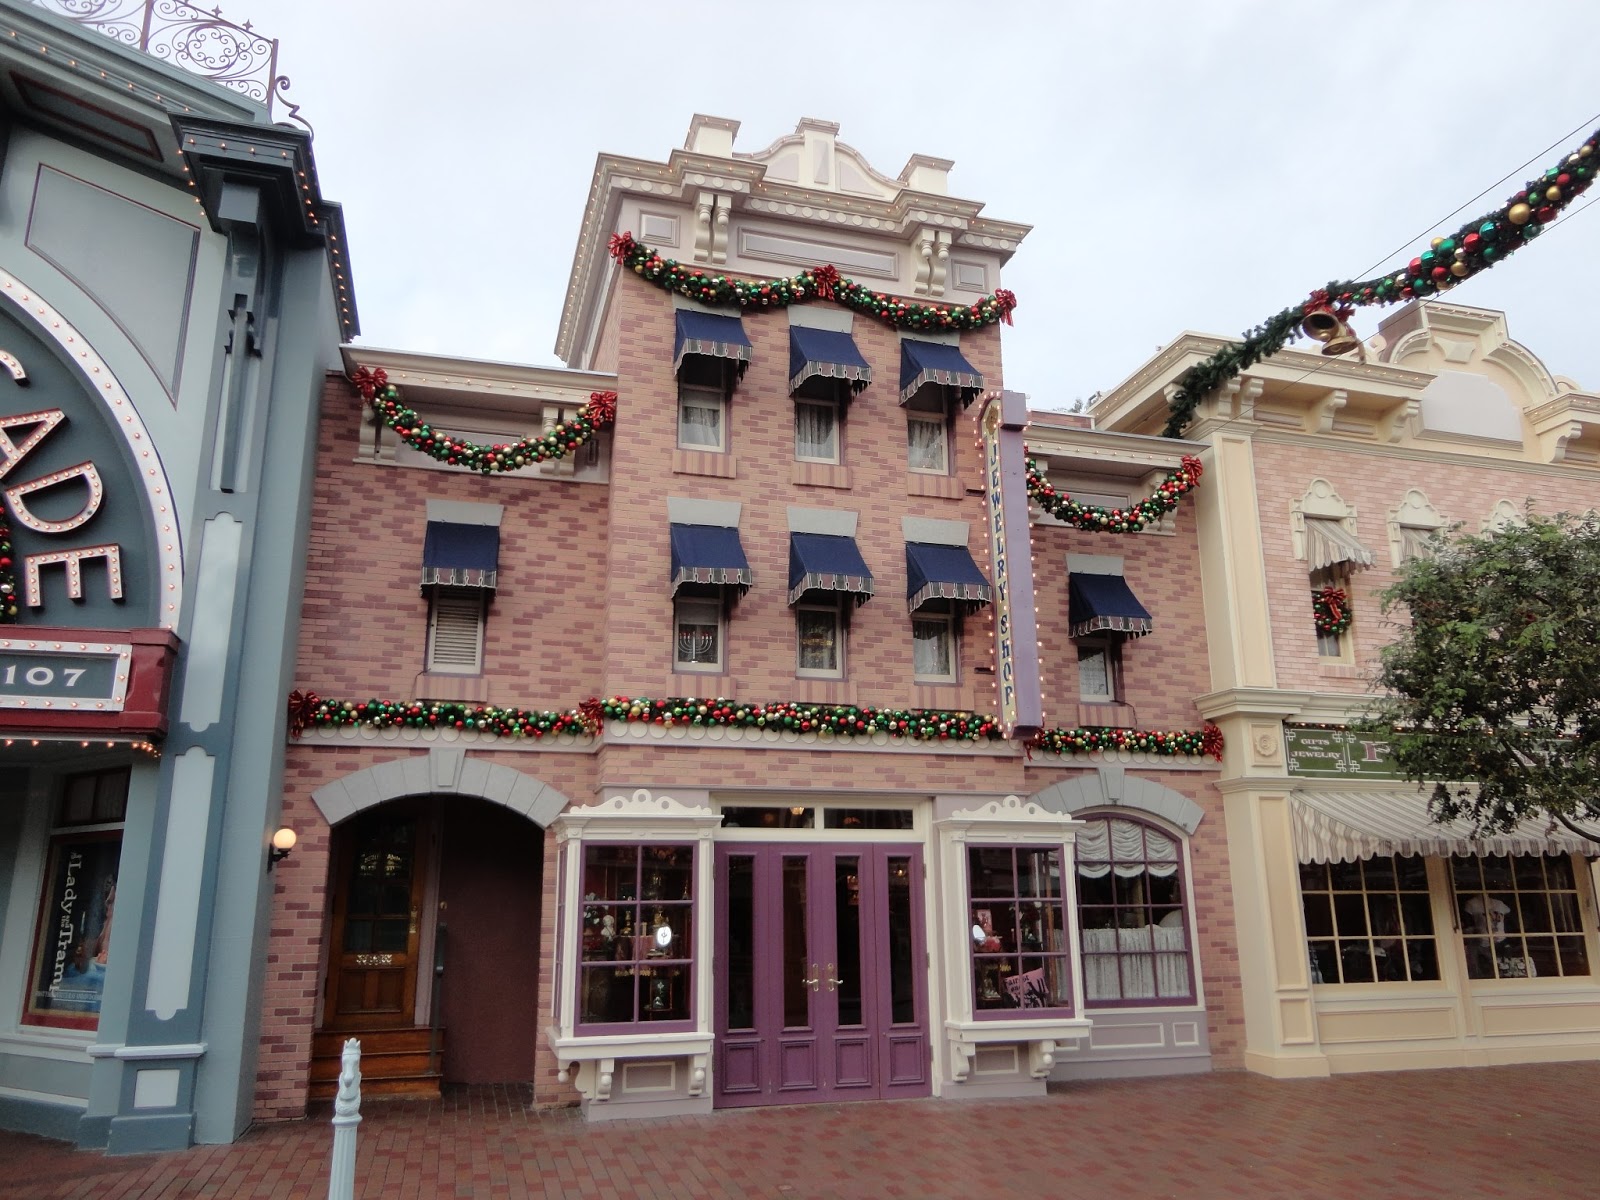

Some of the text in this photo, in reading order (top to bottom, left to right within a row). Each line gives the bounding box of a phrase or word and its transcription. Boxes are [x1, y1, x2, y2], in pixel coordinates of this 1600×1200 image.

[0, 350, 124, 607] ADE
[990, 443, 1013, 706] JEWELRY SHOP
[4, 664, 87, 687] 107
[1291, 750, 1342, 760] JEWELRY
[1300, 738, 1330, 746] GIFTS
[60, 861, 82, 914] Lady
